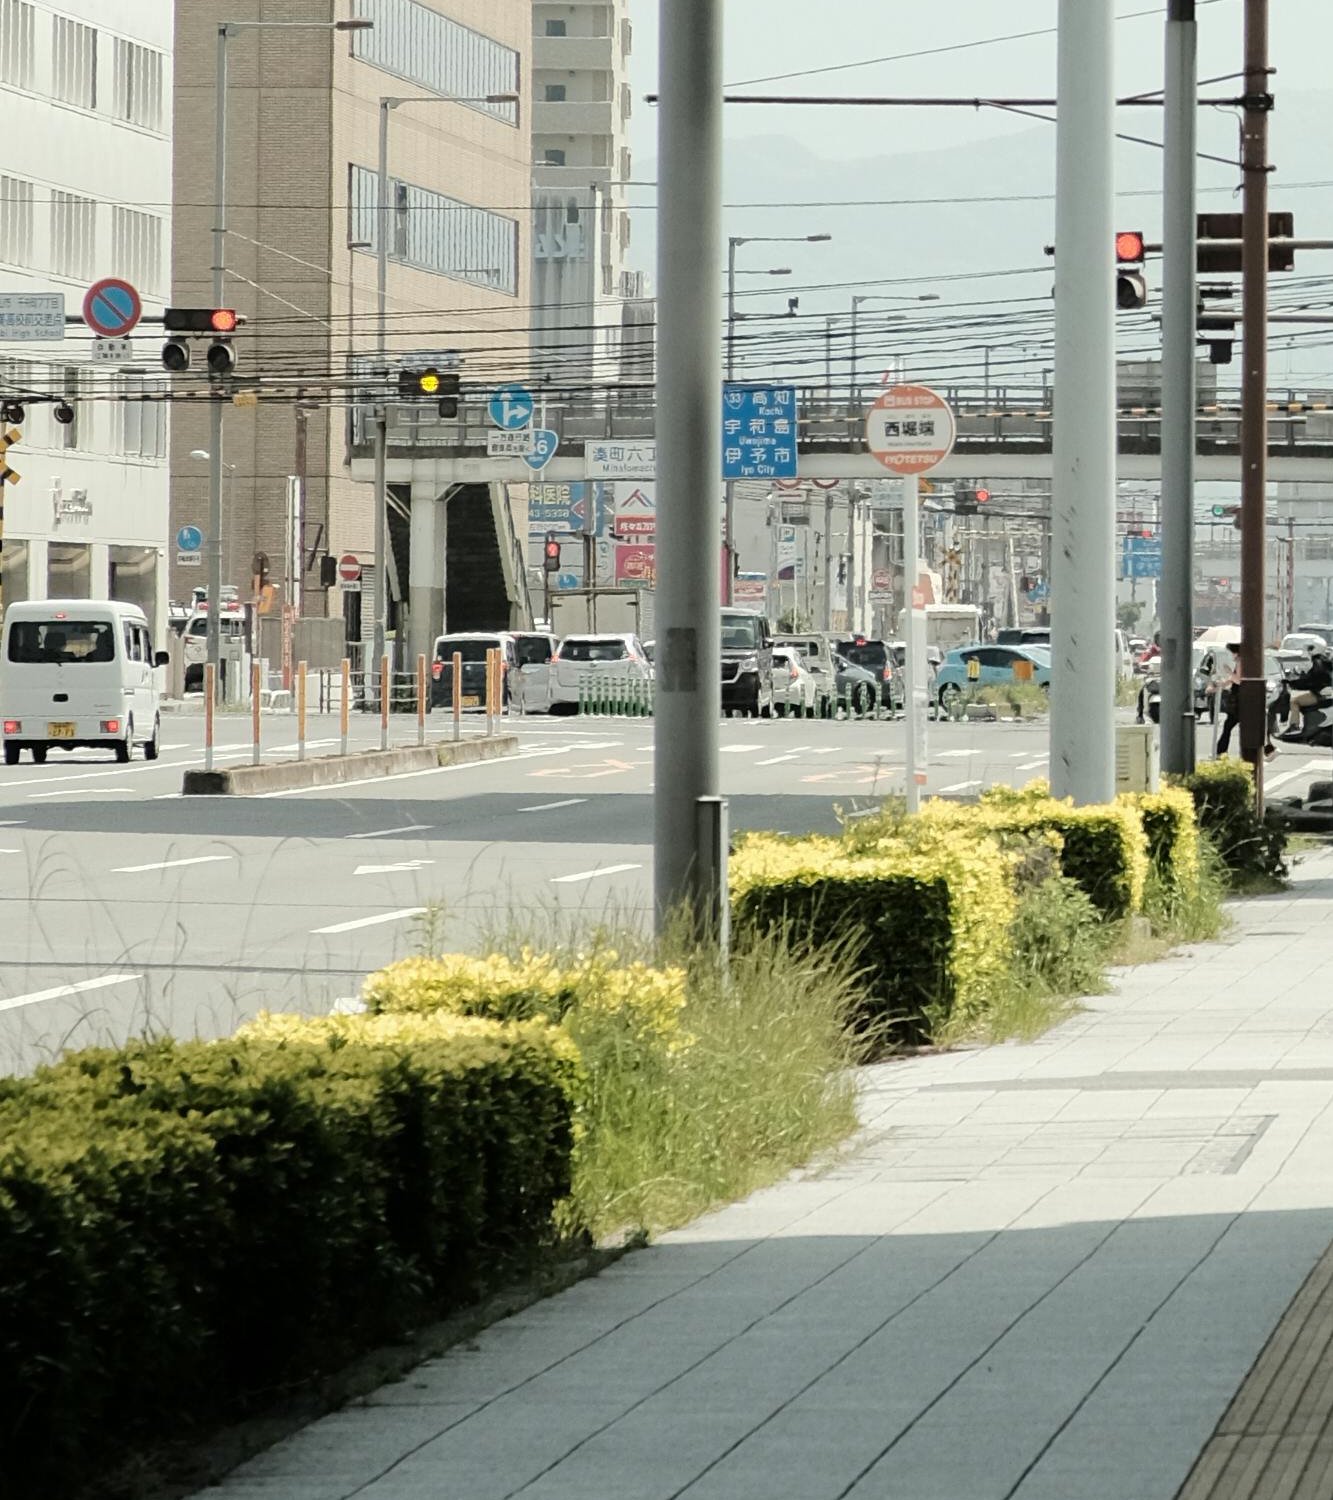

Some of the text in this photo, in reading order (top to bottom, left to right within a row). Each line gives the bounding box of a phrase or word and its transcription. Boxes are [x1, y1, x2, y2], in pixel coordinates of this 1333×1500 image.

[752, 390, 789, 405] 高知
[724, 418, 789, 435] 宇和島
[725, 447, 791, 464] 伊予市
